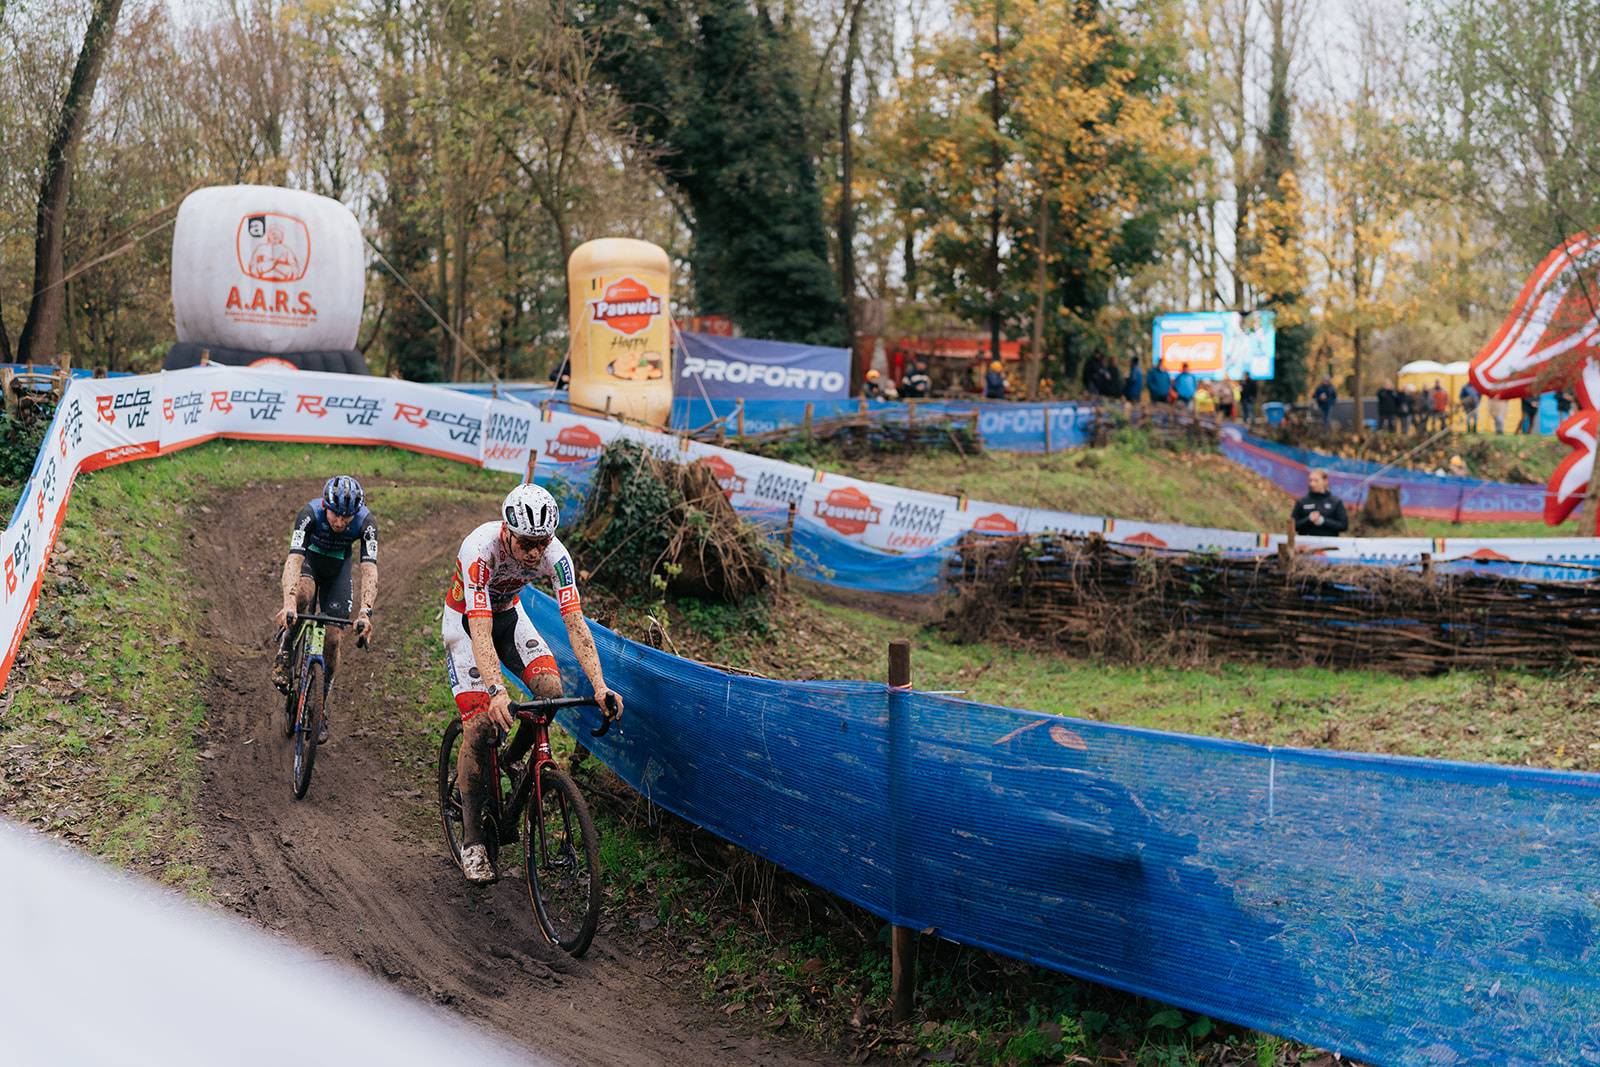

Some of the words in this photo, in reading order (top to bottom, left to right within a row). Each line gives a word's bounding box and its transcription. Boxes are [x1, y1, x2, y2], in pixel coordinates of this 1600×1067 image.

[226, 286, 317, 315] A.A.R.S.
[598, 297, 657, 318] Pauwels
[681, 356, 845, 393] PROFORTO
[96, 387, 152, 425] Recta
[162, 391, 204, 424] Recta
[210, 388, 286, 415] Recta
[250, 403, 282, 420] vit
[295, 394, 383, 418] Recta
[127, 407, 149, 429] vit
[183, 407, 202, 425] vit
[346, 409, 379, 426] vit
[393, 402, 482, 429] Recta
[449, 427, 481, 446] vit
[817, 501, 879, 522] Pauwels
[894, 501, 945, 521] MMM
[889, 514, 941, 535] MMM
